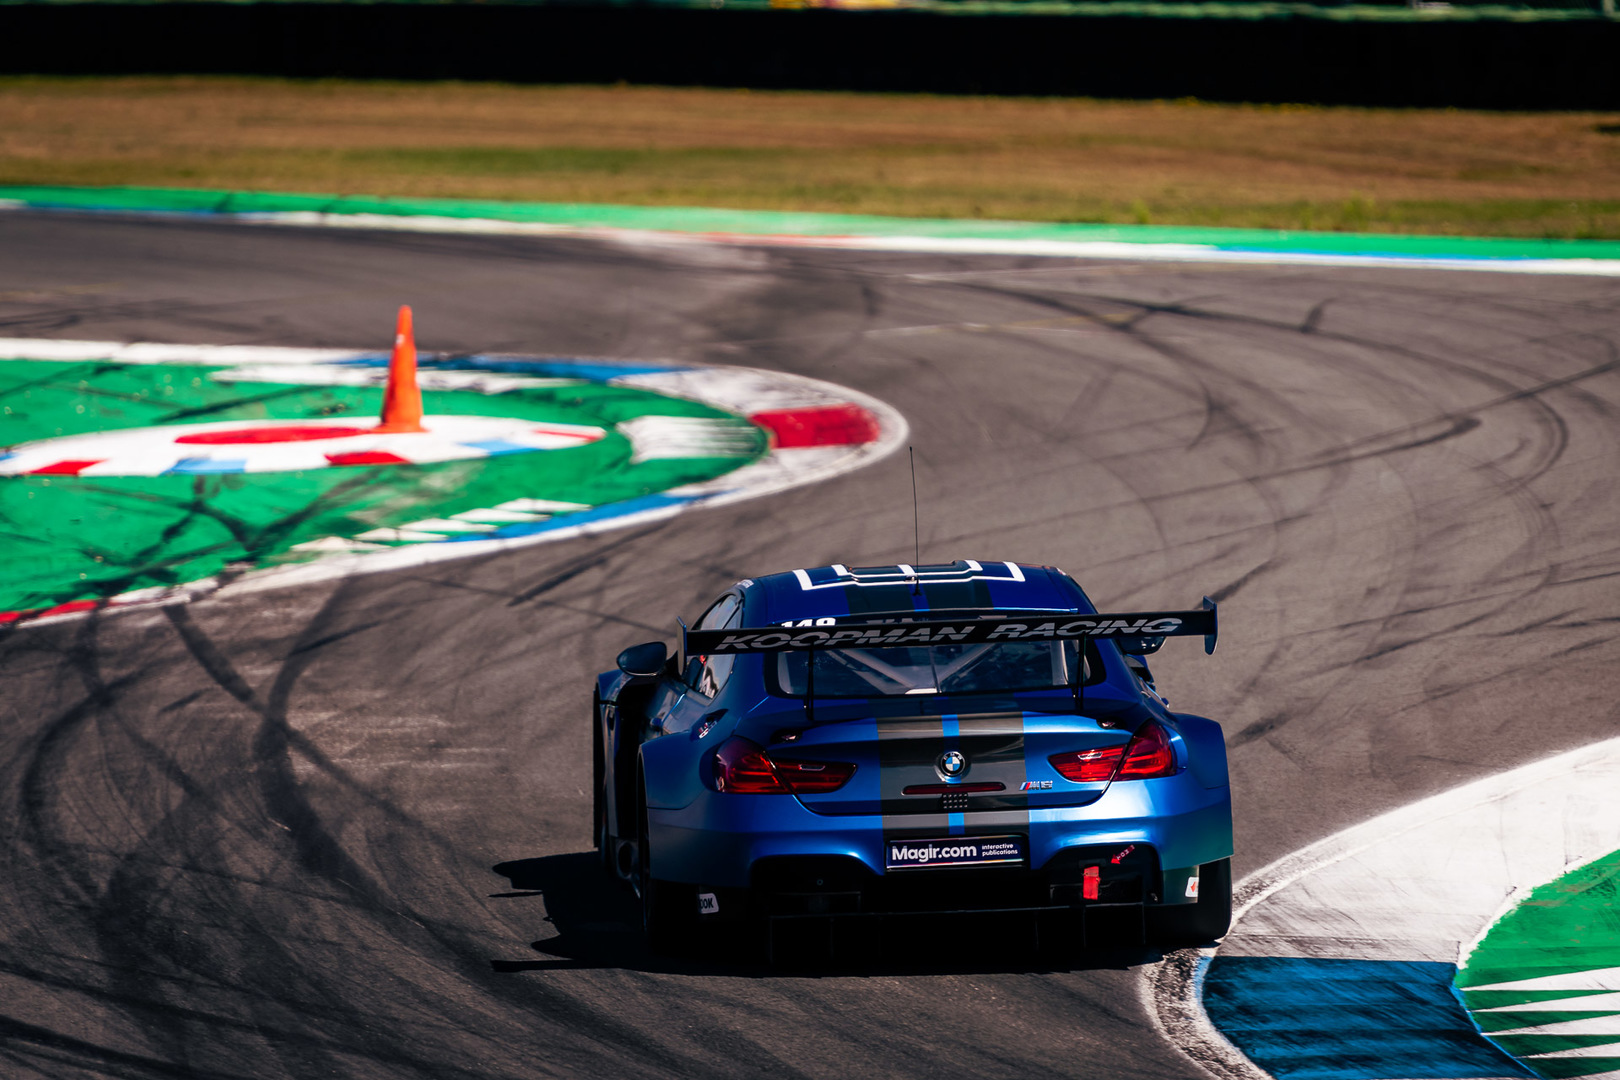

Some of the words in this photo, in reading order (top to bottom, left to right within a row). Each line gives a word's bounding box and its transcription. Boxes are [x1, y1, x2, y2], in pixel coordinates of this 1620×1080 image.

[715, 626, 976, 650] KOOPMAN
[986, 618, 1183, 639] RACING
[892, 844, 977, 862] Magir.com
[982, 848, 1018, 857] publications
